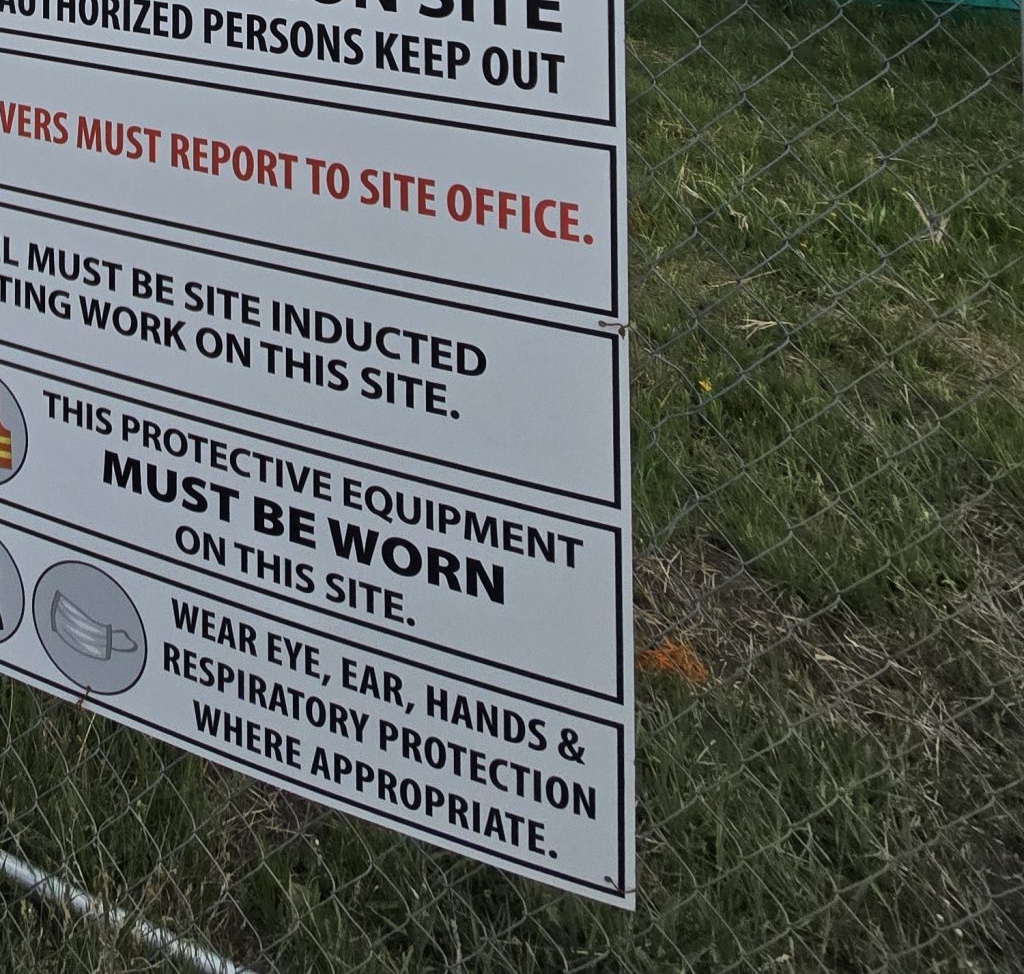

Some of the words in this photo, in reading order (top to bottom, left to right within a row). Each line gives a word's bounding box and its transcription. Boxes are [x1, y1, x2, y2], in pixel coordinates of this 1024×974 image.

[204, 8, 363, 65] PERSONS
[376, 31, 470, 80] KEEP
[482, 46, 565, 94] OUT
[77, 116, 161, 162] MUST
[171, 133, 297, 189] REPORT
[306, 158, 349, 199] TO
[360, 168, 435, 215] SITE
[446, 184, 593, 245] OFFICE.
[28, 242, 122, 292] MUST
[132, 268, 174, 306] BE
[185, 282, 260, 327] SITE
[272, 300, 486, 376] INDUCTED
[79, 295, 186, 351] WORK
[196, 327, 250, 368] ON
[260, 341, 349, 391] THIS
[361, 367, 460, 419] SITE.
[43, 390, 112, 435] THIS
[122, 414, 332, 502] PROTECTIVE
[343, 477, 583, 569] EQUIPMENT
[103, 450, 239, 523] MUST
[254, 496, 316, 549] BE
[327, 517, 504, 605] WORN
[175, 526, 225, 566] ON
[234, 542, 315, 593] THIS
[326, 573, 415, 626] SITE.
[164, 642, 369, 743] RESPIRATORY
[379, 719, 596, 820] PROTECTION
[171, 597, 257, 657] WEAR
[267, 632, 331, 686] EYE,
[342, 657, 415, 714] EAR,
[427, 684, 547, 751] HANDS
[558, 728, 585, 765] &
[193, 699, 301, 770] WHERE
[310, 746, 557, 859] APPROPRIATE.
